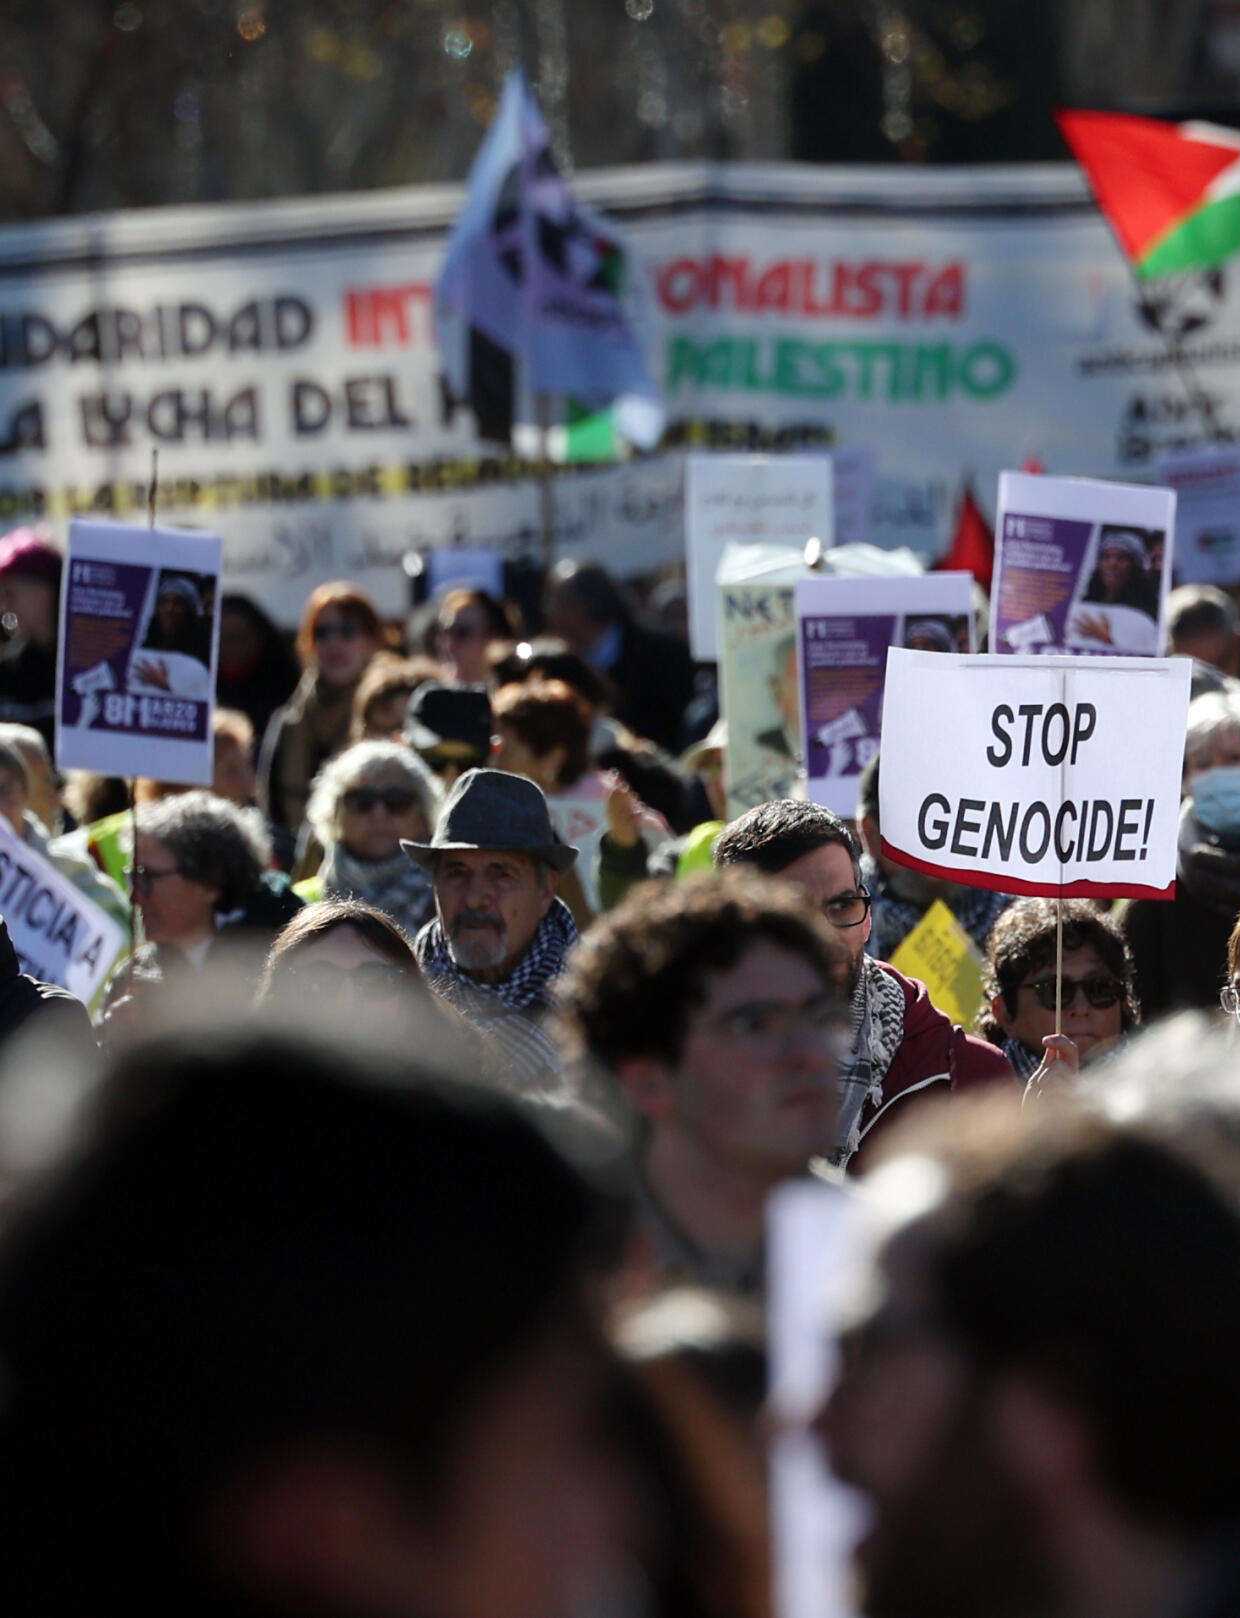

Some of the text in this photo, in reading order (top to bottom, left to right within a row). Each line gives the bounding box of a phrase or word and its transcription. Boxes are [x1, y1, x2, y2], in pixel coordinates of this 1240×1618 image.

[294, 375, 410, 433] DEL
[986, 702, 1098, 768] STOP
[917, 792, 1156, 865] GENOCIDE!
